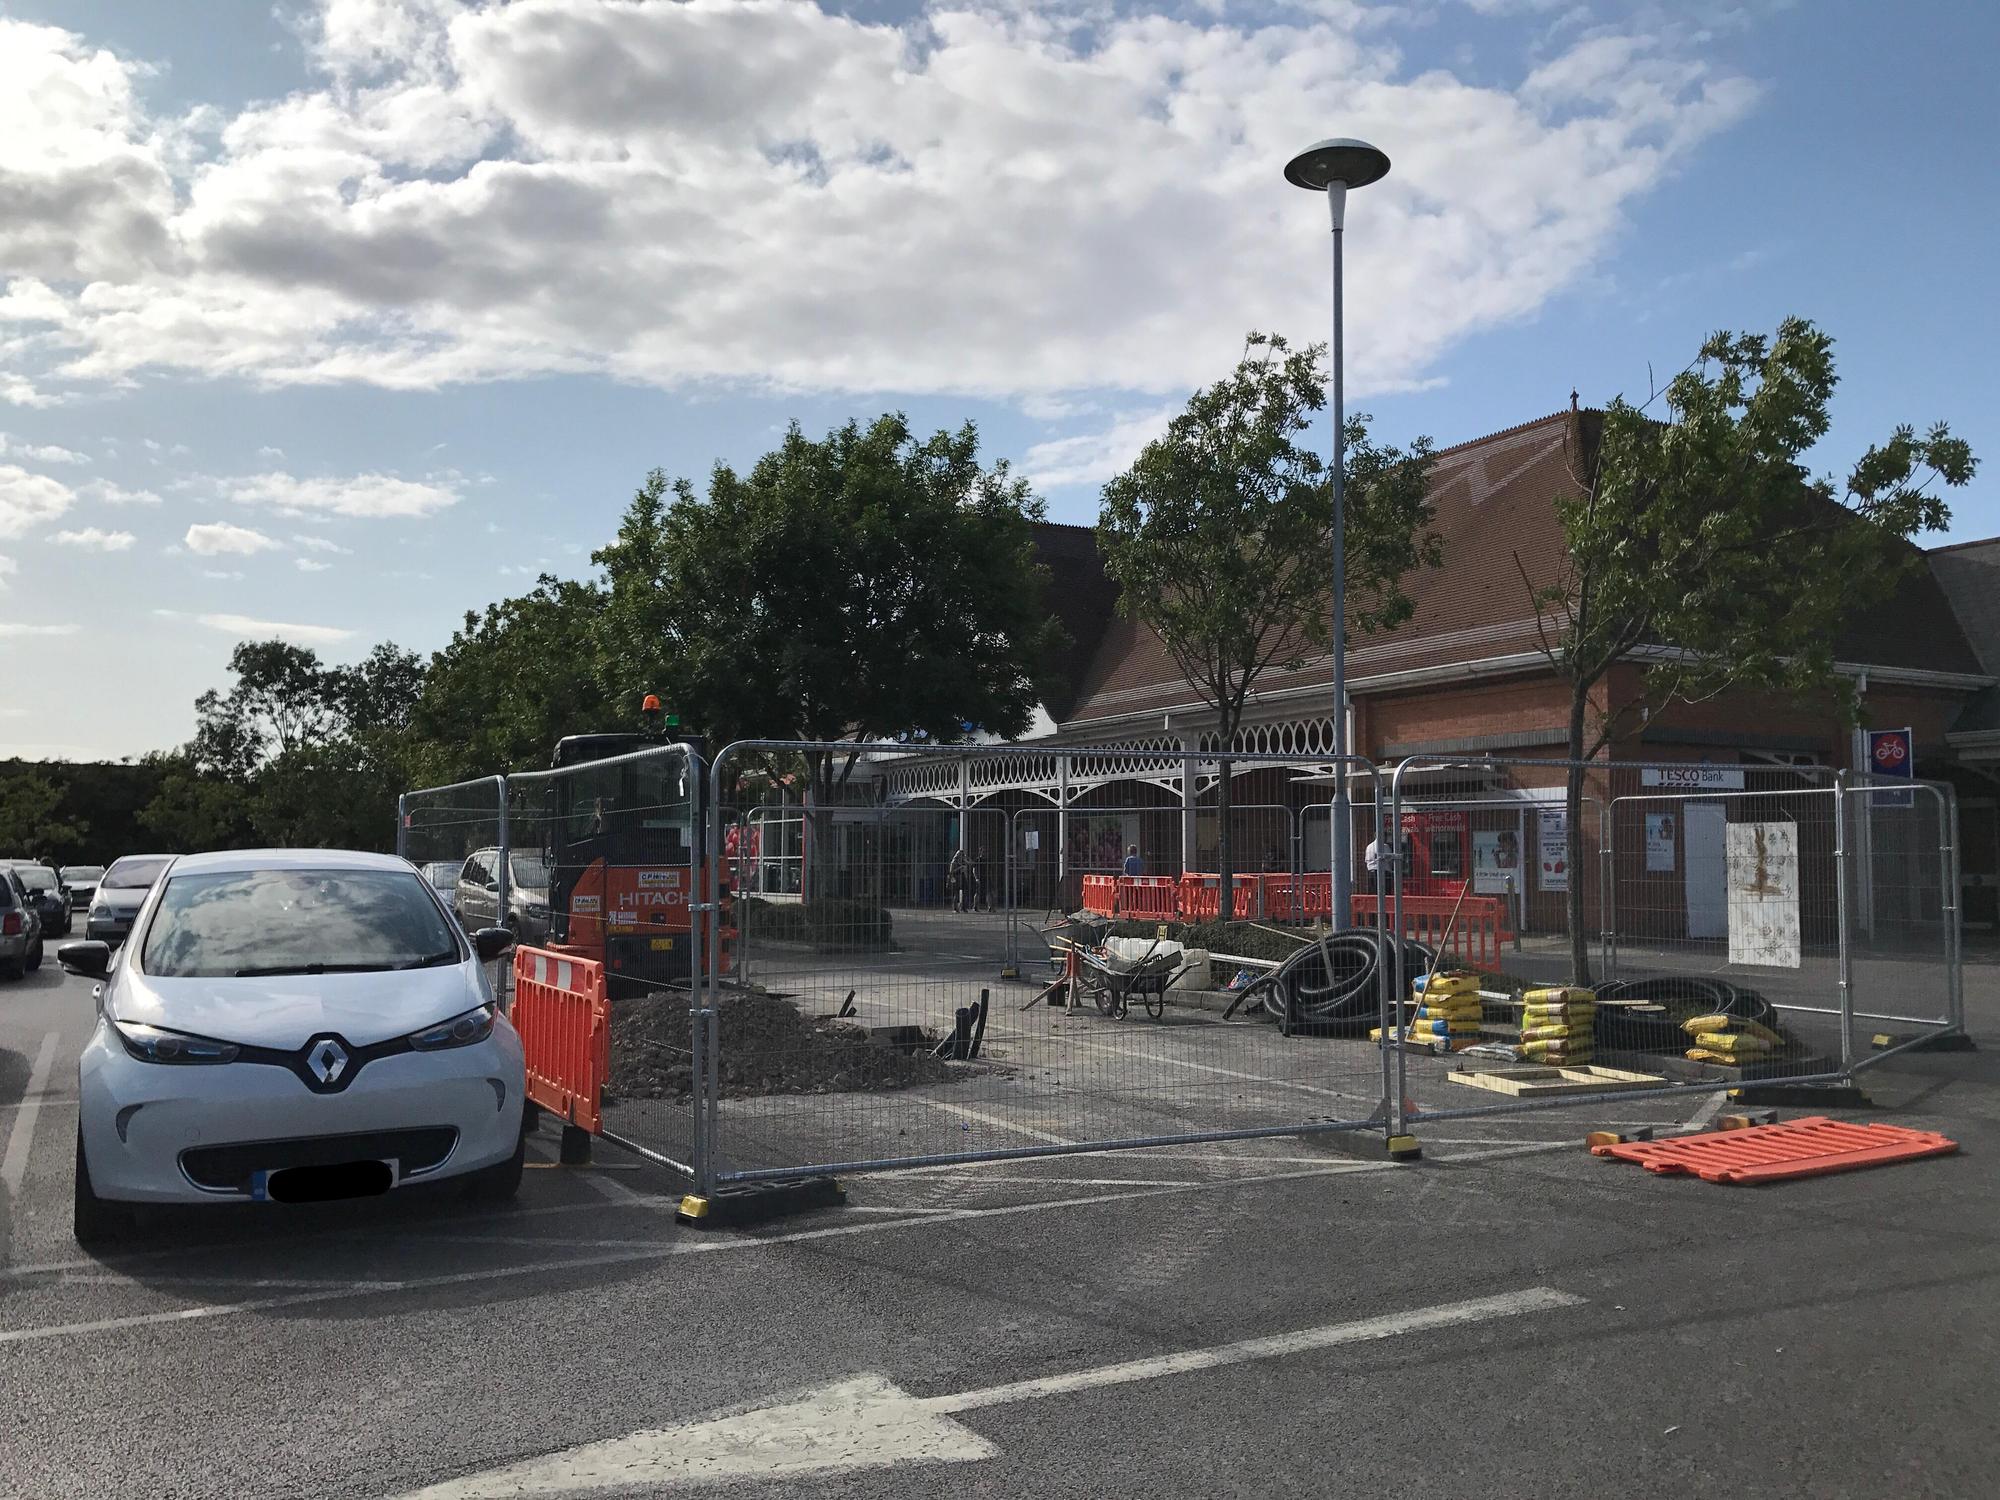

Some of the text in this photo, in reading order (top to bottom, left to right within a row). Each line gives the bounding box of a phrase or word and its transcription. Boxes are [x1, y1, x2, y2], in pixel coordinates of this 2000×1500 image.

[1658, 769, 1724, 782] TESCO Bank
[619, 891, 692, 906] HITACH
